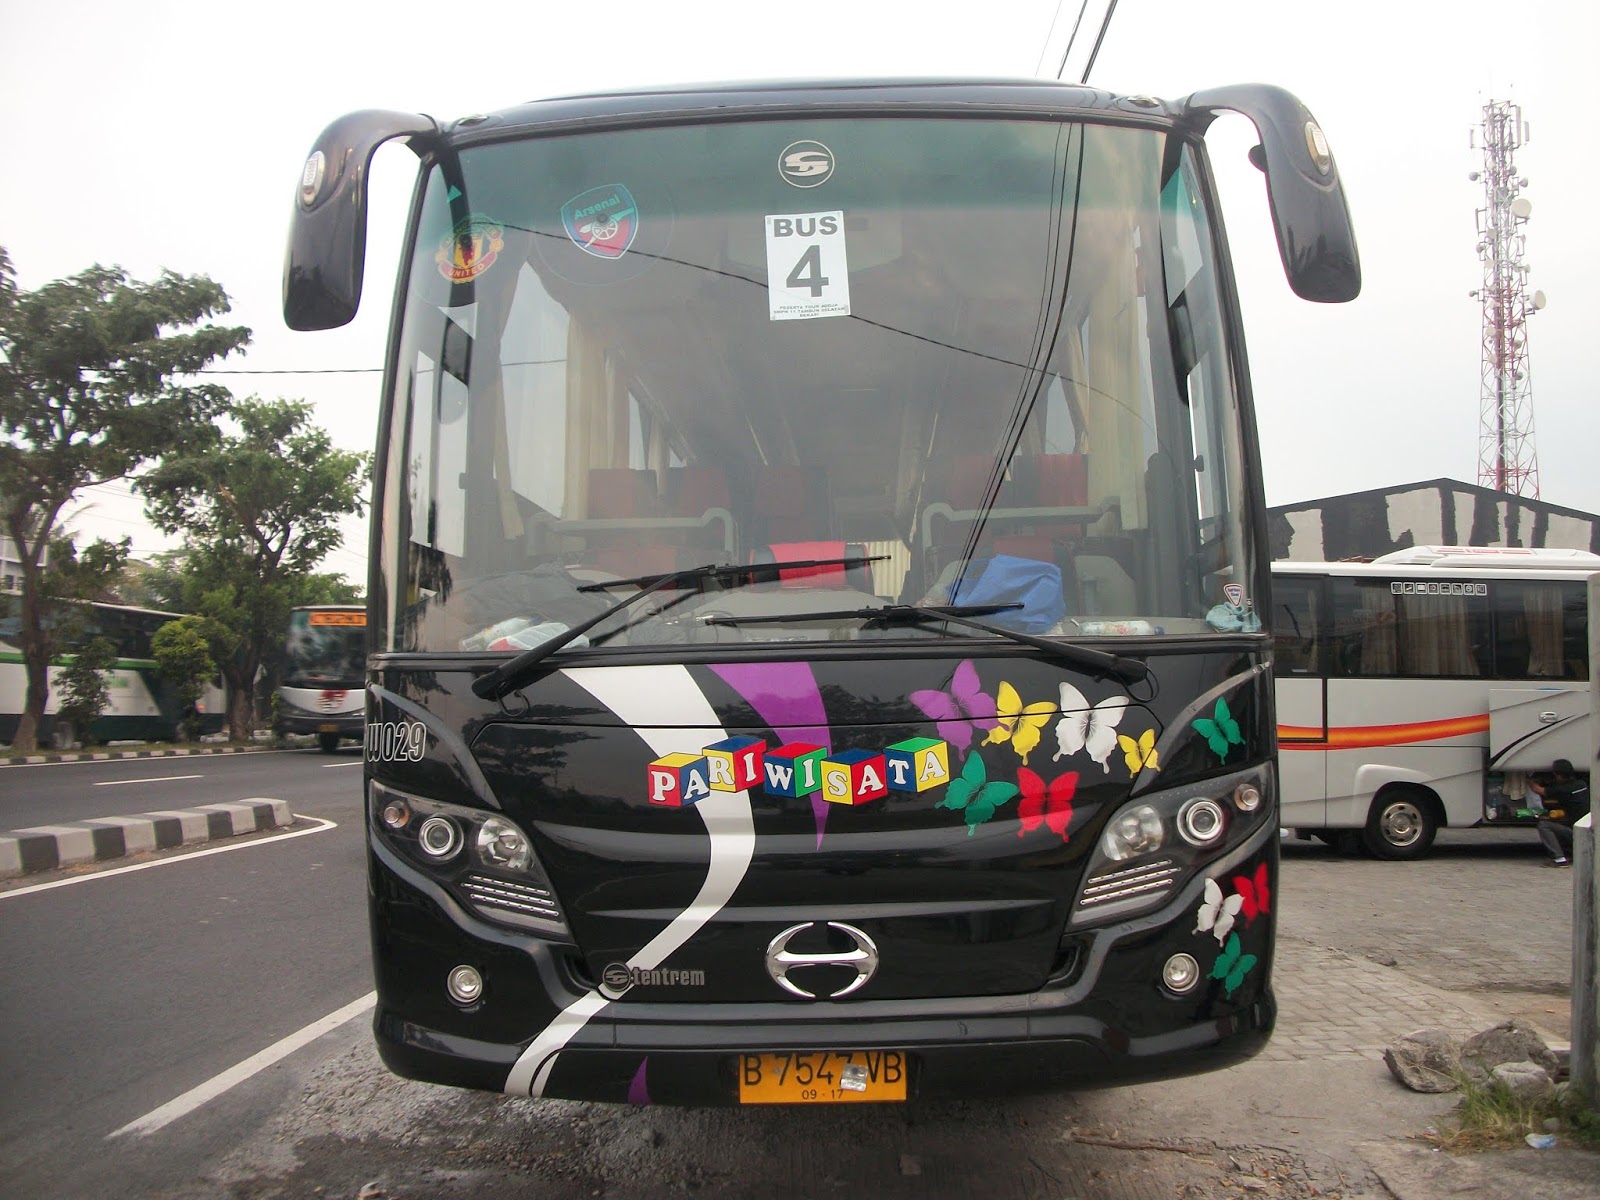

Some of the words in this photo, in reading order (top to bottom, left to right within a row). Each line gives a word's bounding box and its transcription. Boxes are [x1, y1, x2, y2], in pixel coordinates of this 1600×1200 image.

[574, 193, 620, 220] Arsenal
[773, 215, 838, 238] BUS
[448, 263, 485, 277] UNITED
[785, 244, 830, 298] 4
[650, 750, 946, 801] PARIWISATA
[743, 1053, 763, 1086] B
[864, 1050, 902, 1084] VB
